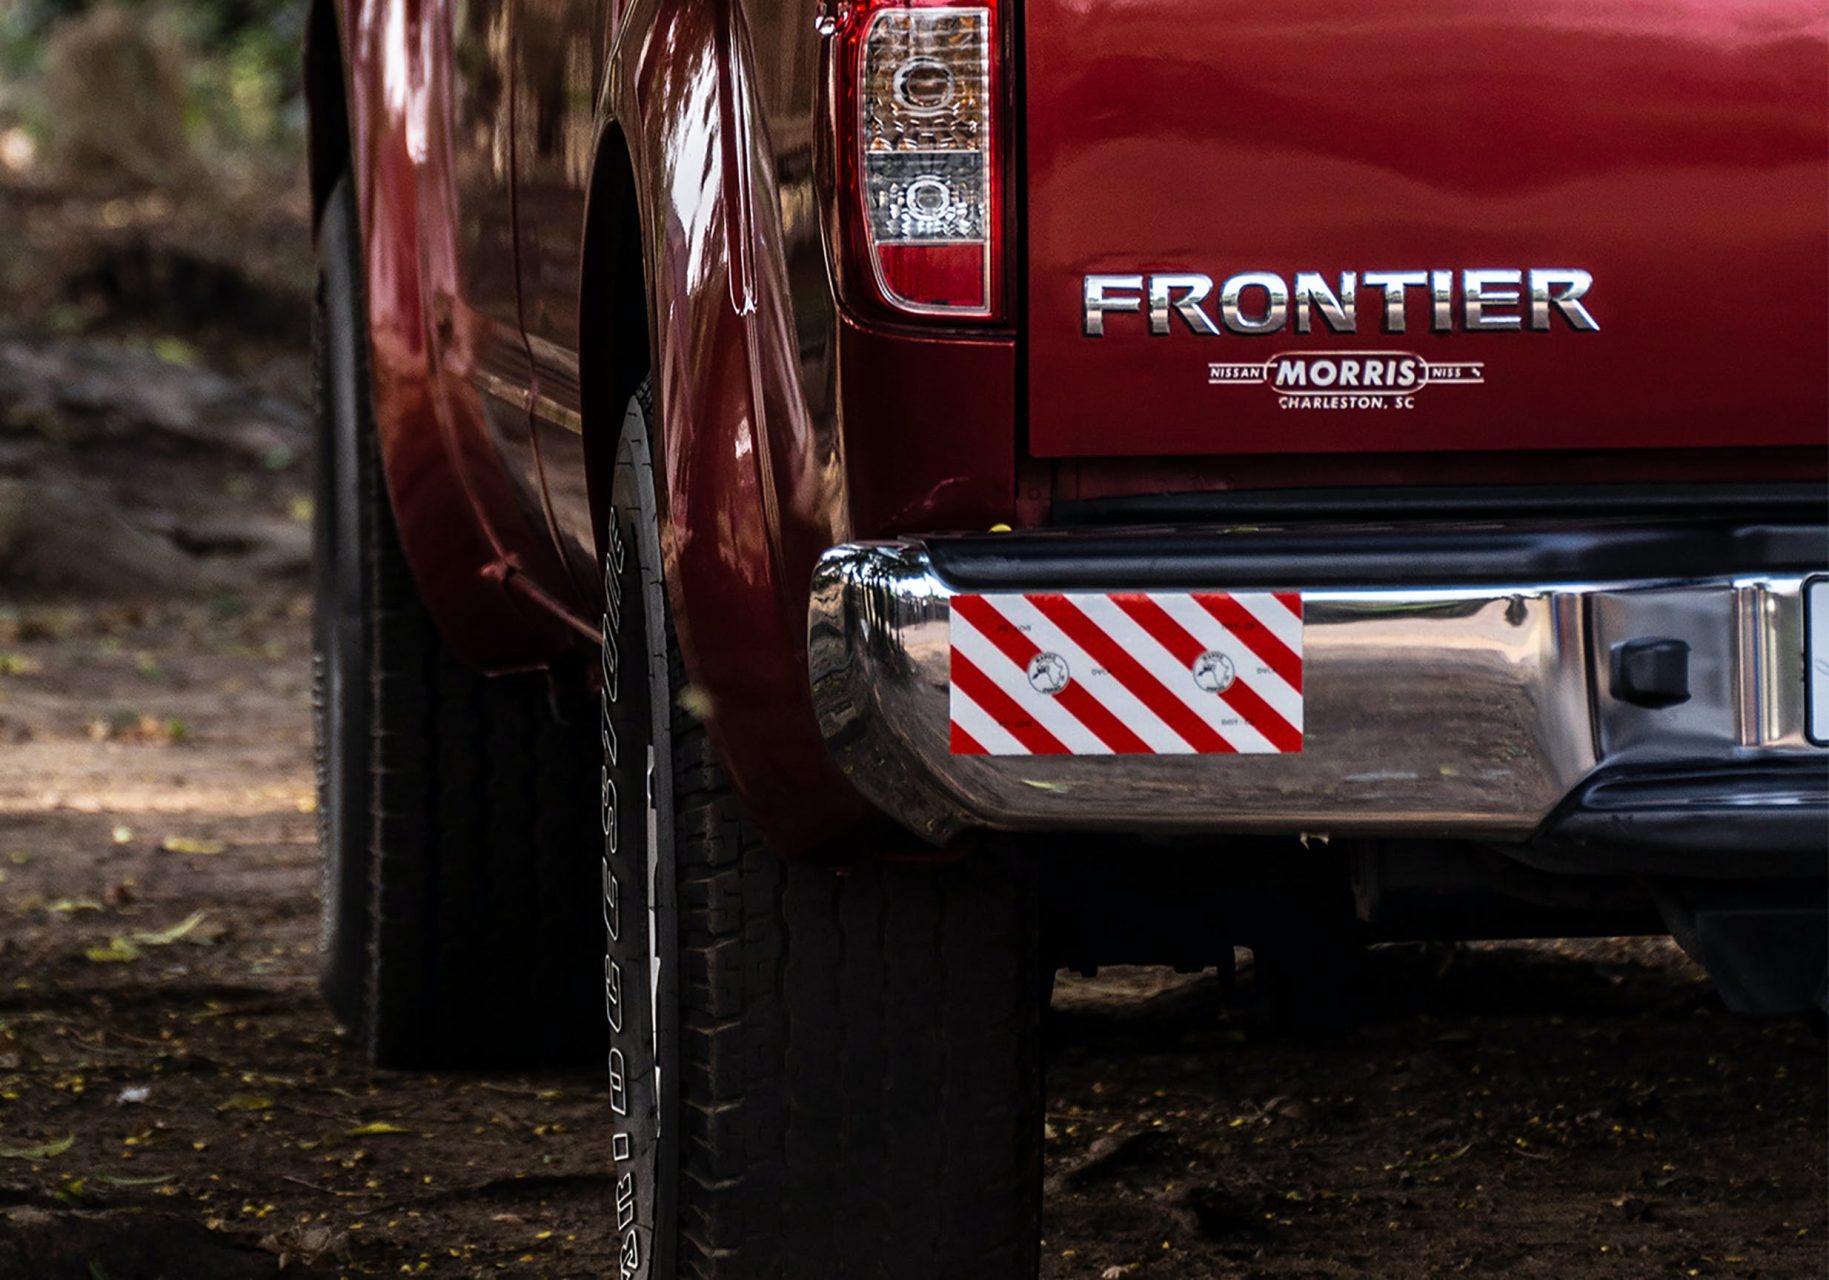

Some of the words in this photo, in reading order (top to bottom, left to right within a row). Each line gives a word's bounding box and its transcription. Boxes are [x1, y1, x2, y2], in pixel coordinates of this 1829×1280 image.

[1083, 269, 1600, 337] FRONTIER
[1210, 368, 1261, 379] NISSAN
[1275, 360, 1416, 386] MORRIS
[1395, 397, 1415, 410] SC
